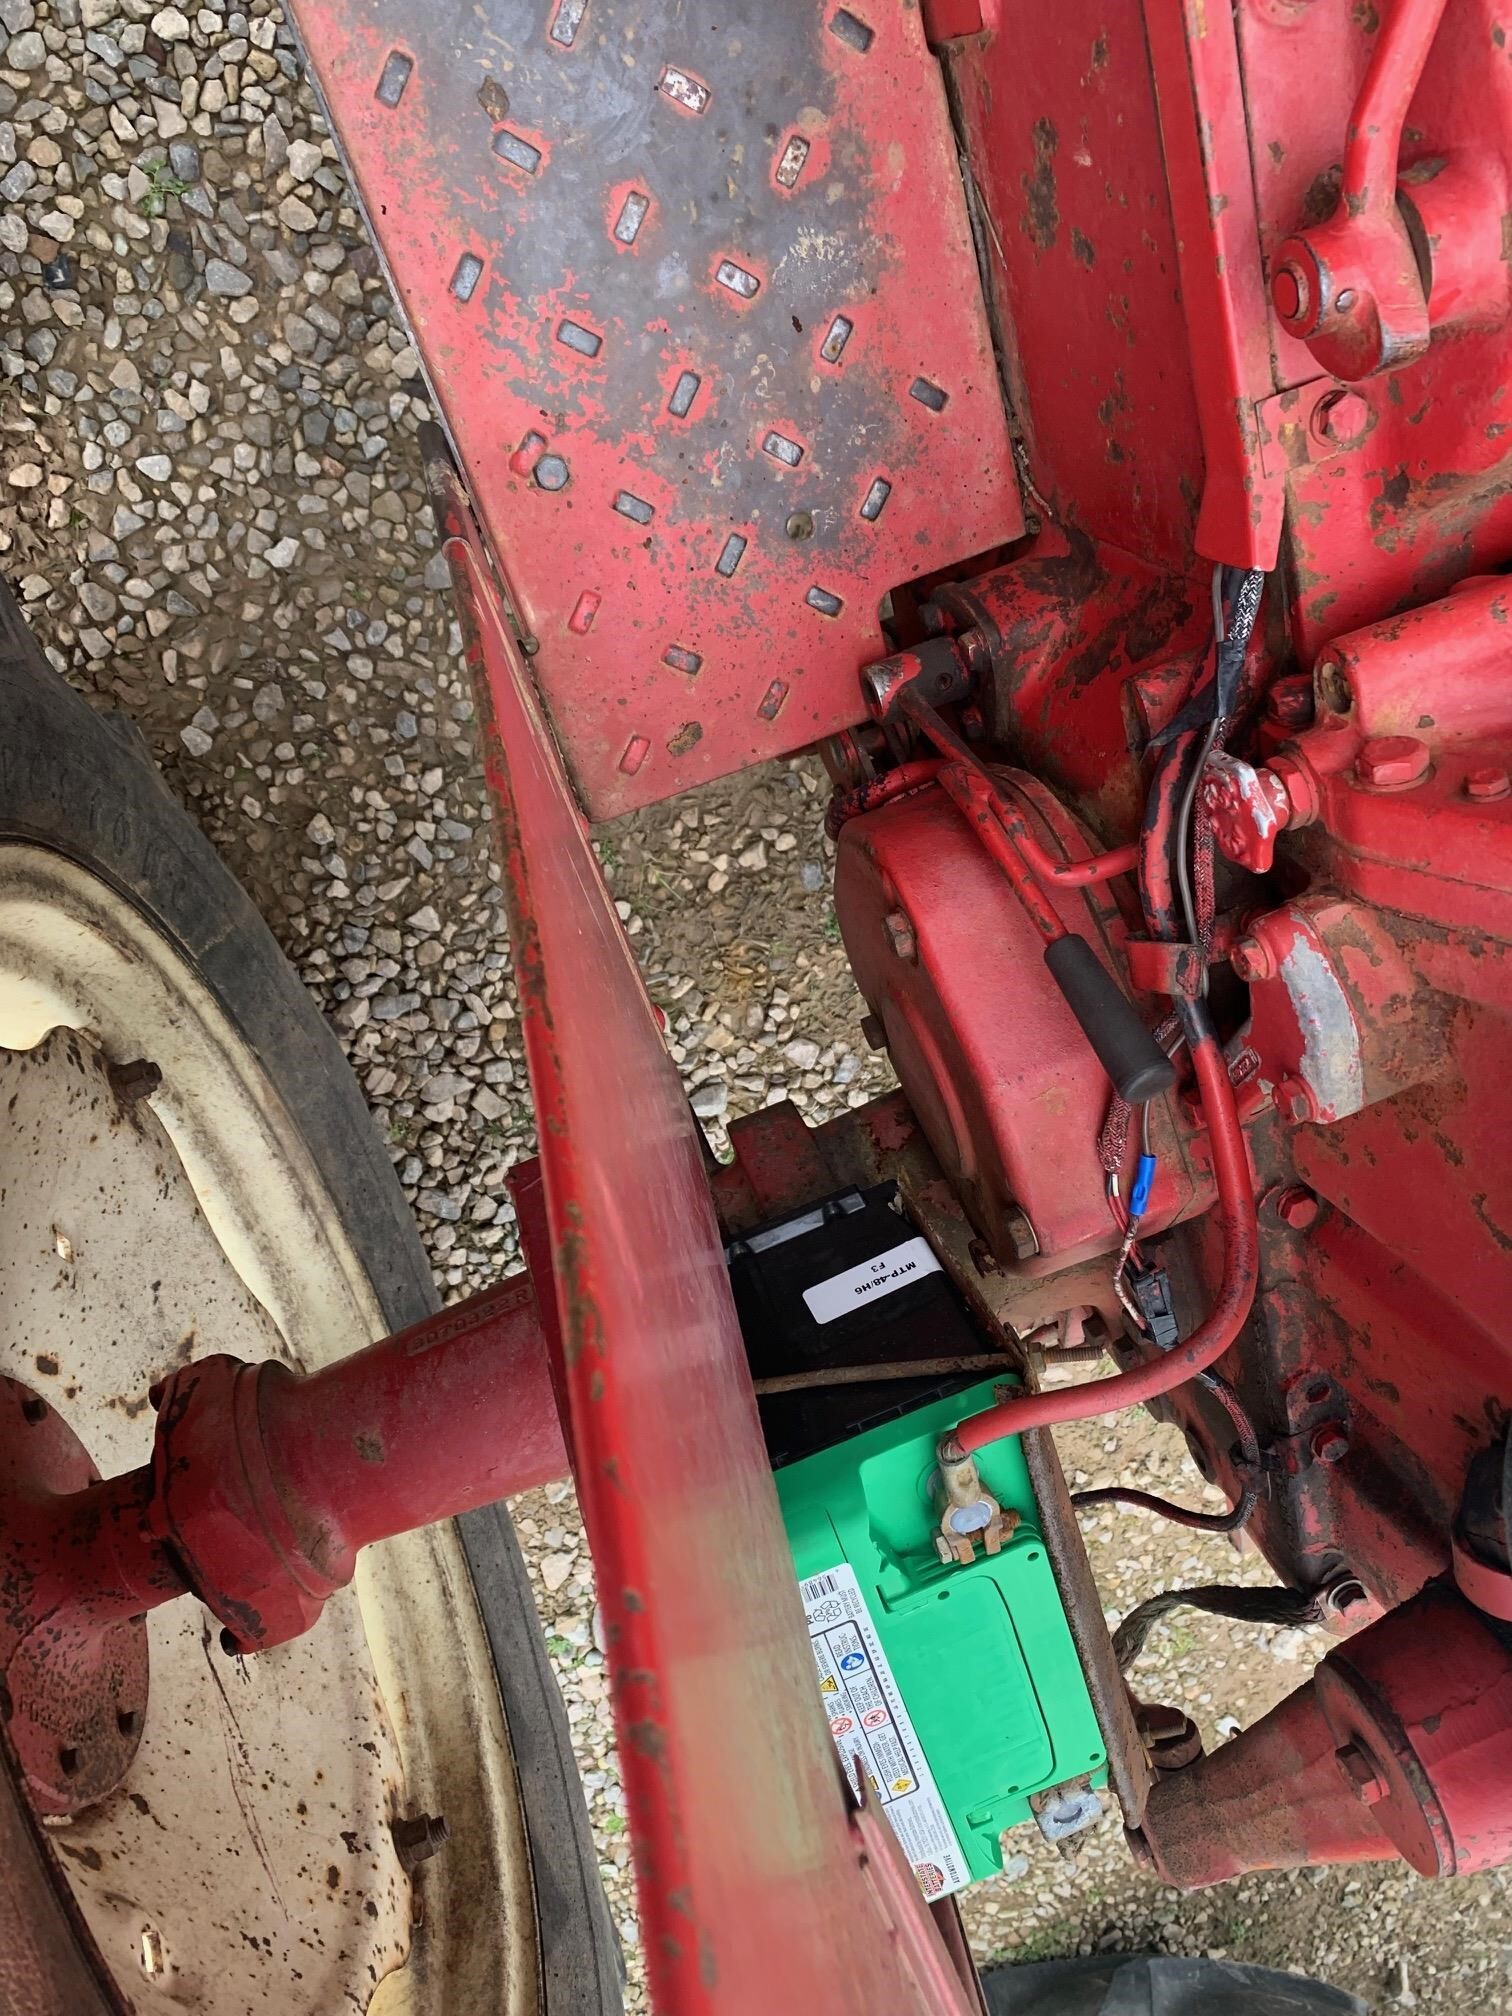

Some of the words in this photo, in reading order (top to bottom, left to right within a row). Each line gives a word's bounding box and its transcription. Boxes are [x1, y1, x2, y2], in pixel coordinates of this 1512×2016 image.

[853, 1260, 917, 1296] MTP-48/H6
[914, 1862, 935, 1897] INTERSTATE
[923, 1861, 942, 1893] BATTERIES
[941, 1852, 961, 1884] AUTOMOTIVE
